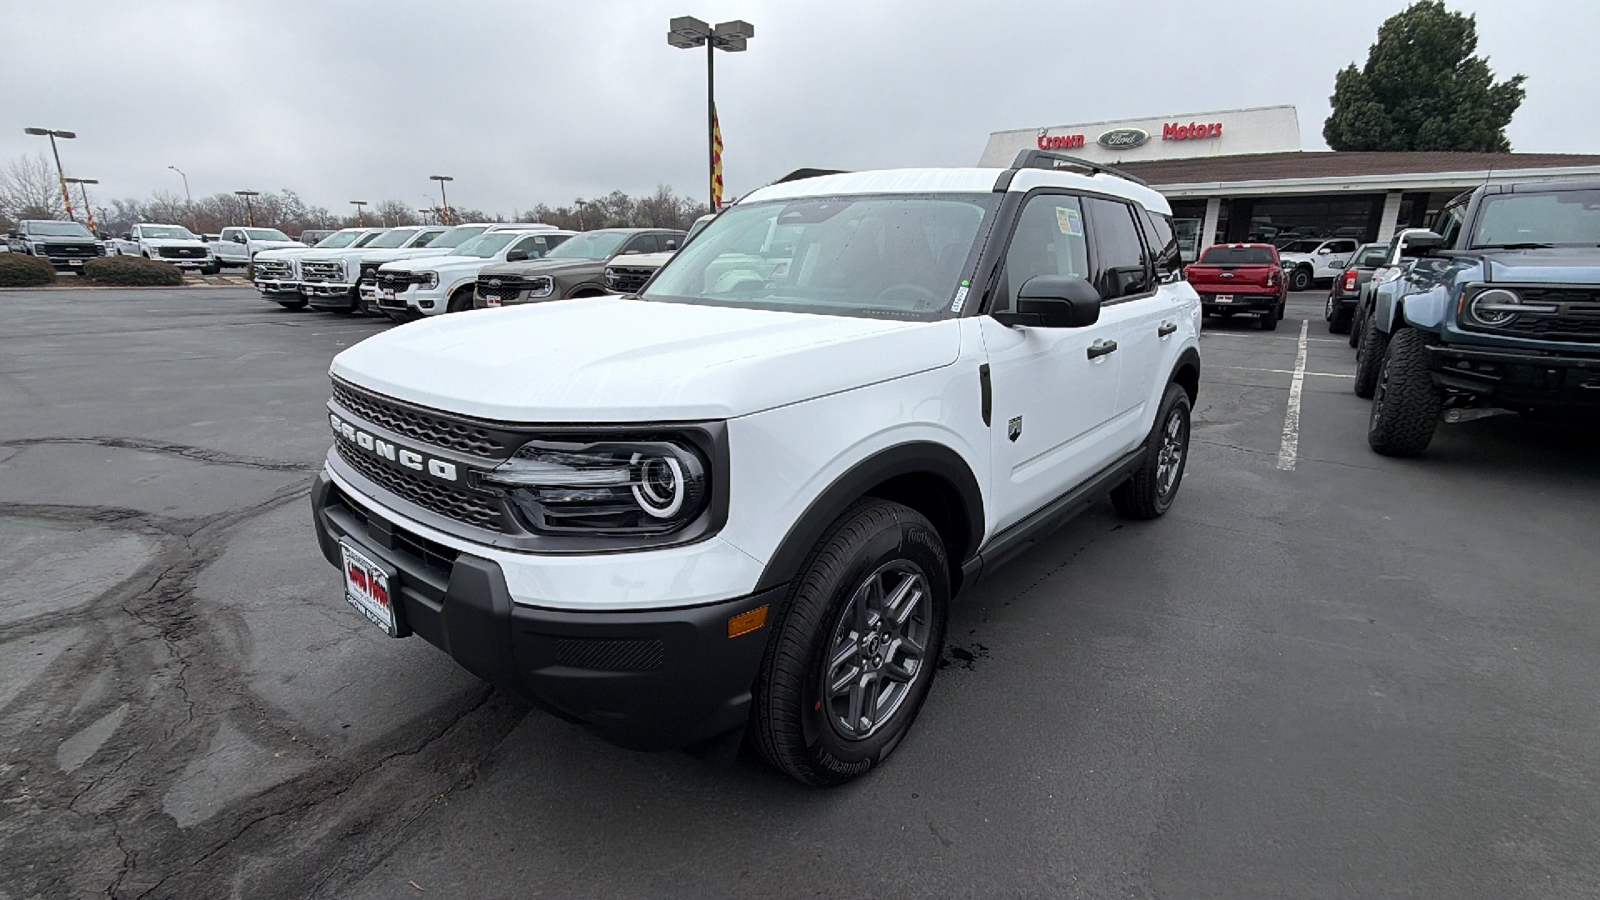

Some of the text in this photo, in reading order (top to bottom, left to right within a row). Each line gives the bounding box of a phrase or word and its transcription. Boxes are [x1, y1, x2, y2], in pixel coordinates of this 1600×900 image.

[1037, 122, 1222, 150] Crown Motors
[1109, 132, 1136, 145] Ford
[330, 414, 457, 481] BRONCO
